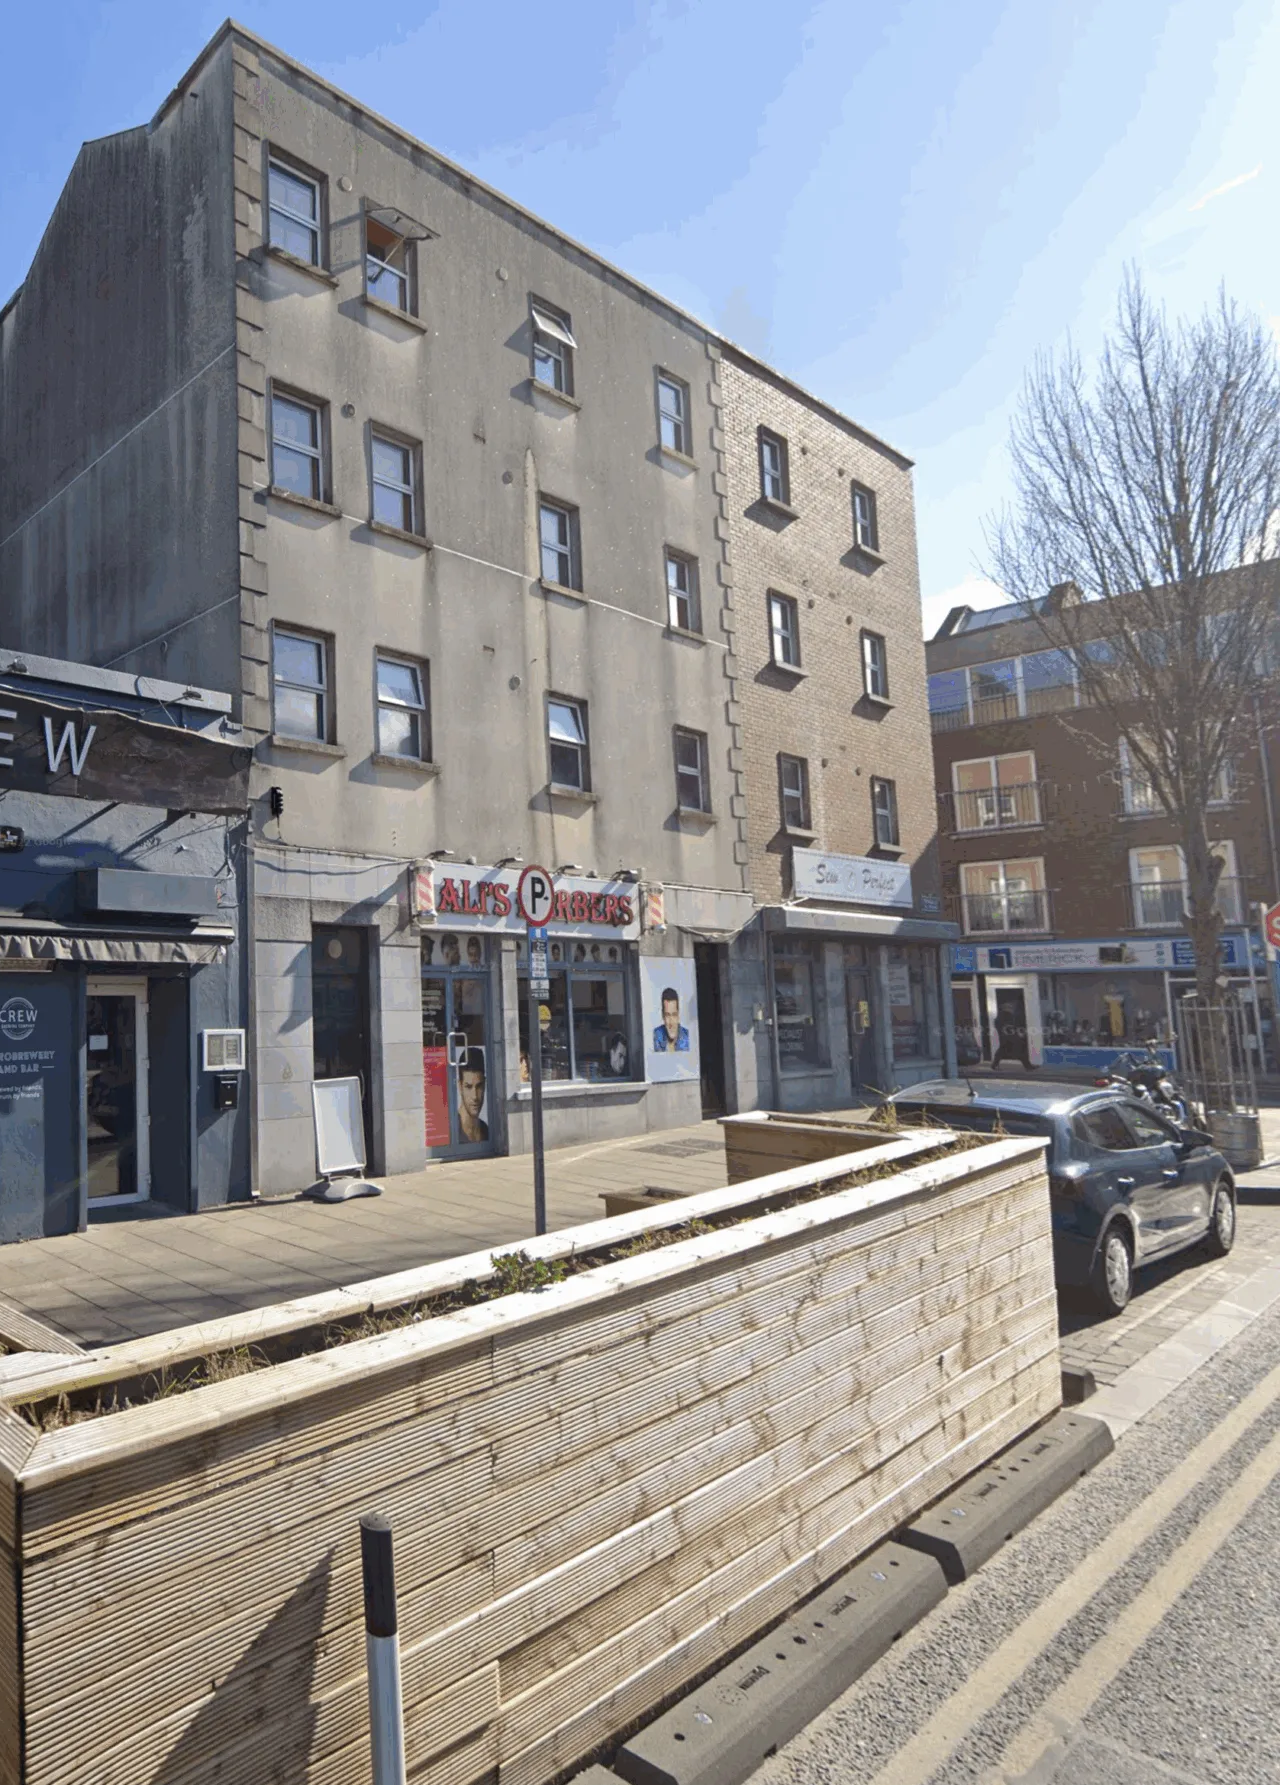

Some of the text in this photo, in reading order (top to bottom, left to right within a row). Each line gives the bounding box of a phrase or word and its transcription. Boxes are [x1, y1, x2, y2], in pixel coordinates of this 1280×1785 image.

[815, 863, 839, 885] Sew
[438, 877, 634, 927] ALI'S RBERS
[21, 1063, 39, 1073] BAR
